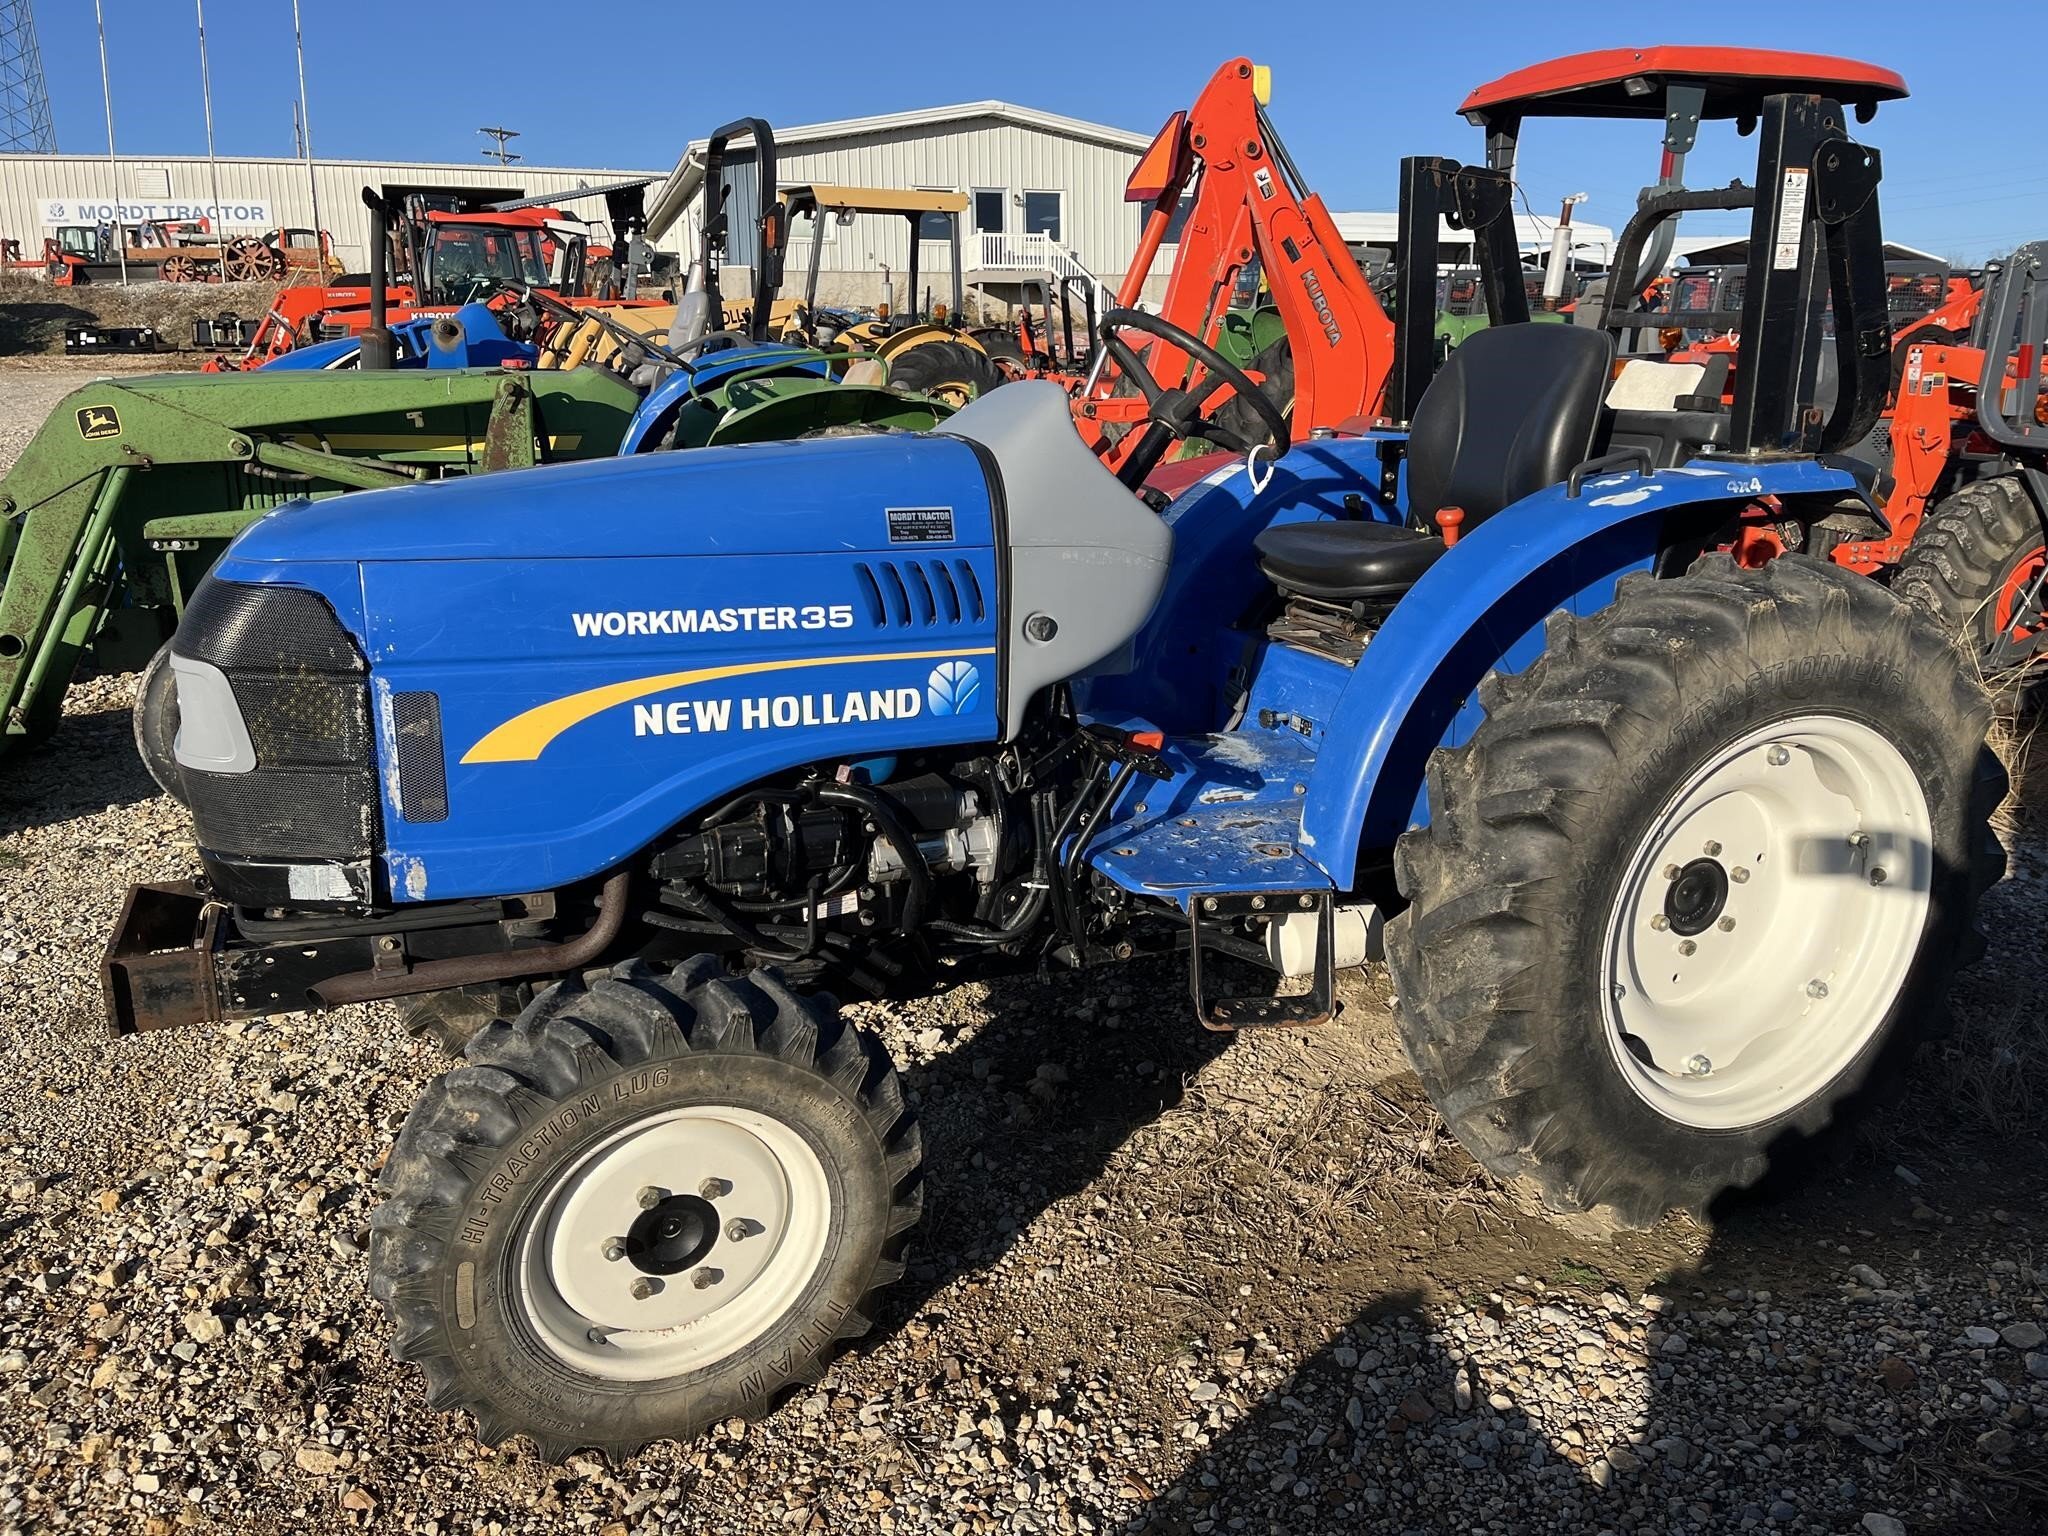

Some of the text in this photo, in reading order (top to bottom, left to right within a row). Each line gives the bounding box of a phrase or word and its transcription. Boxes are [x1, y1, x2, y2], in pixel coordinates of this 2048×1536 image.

[78, 205, 265, 220] MORDT TRACTOR
[1300, 268, 1343, 348] KUBOTA
[100, 428, 119, 436] DEERE
[890, 511, 950, 521] MORDT TRACTOR
[633, 687, 922, 738] NEW HOLLAND
[460, 1067, 671, 1245] HI-TRACTION LUG
[739, 1299, 851, 1402] TITAN
